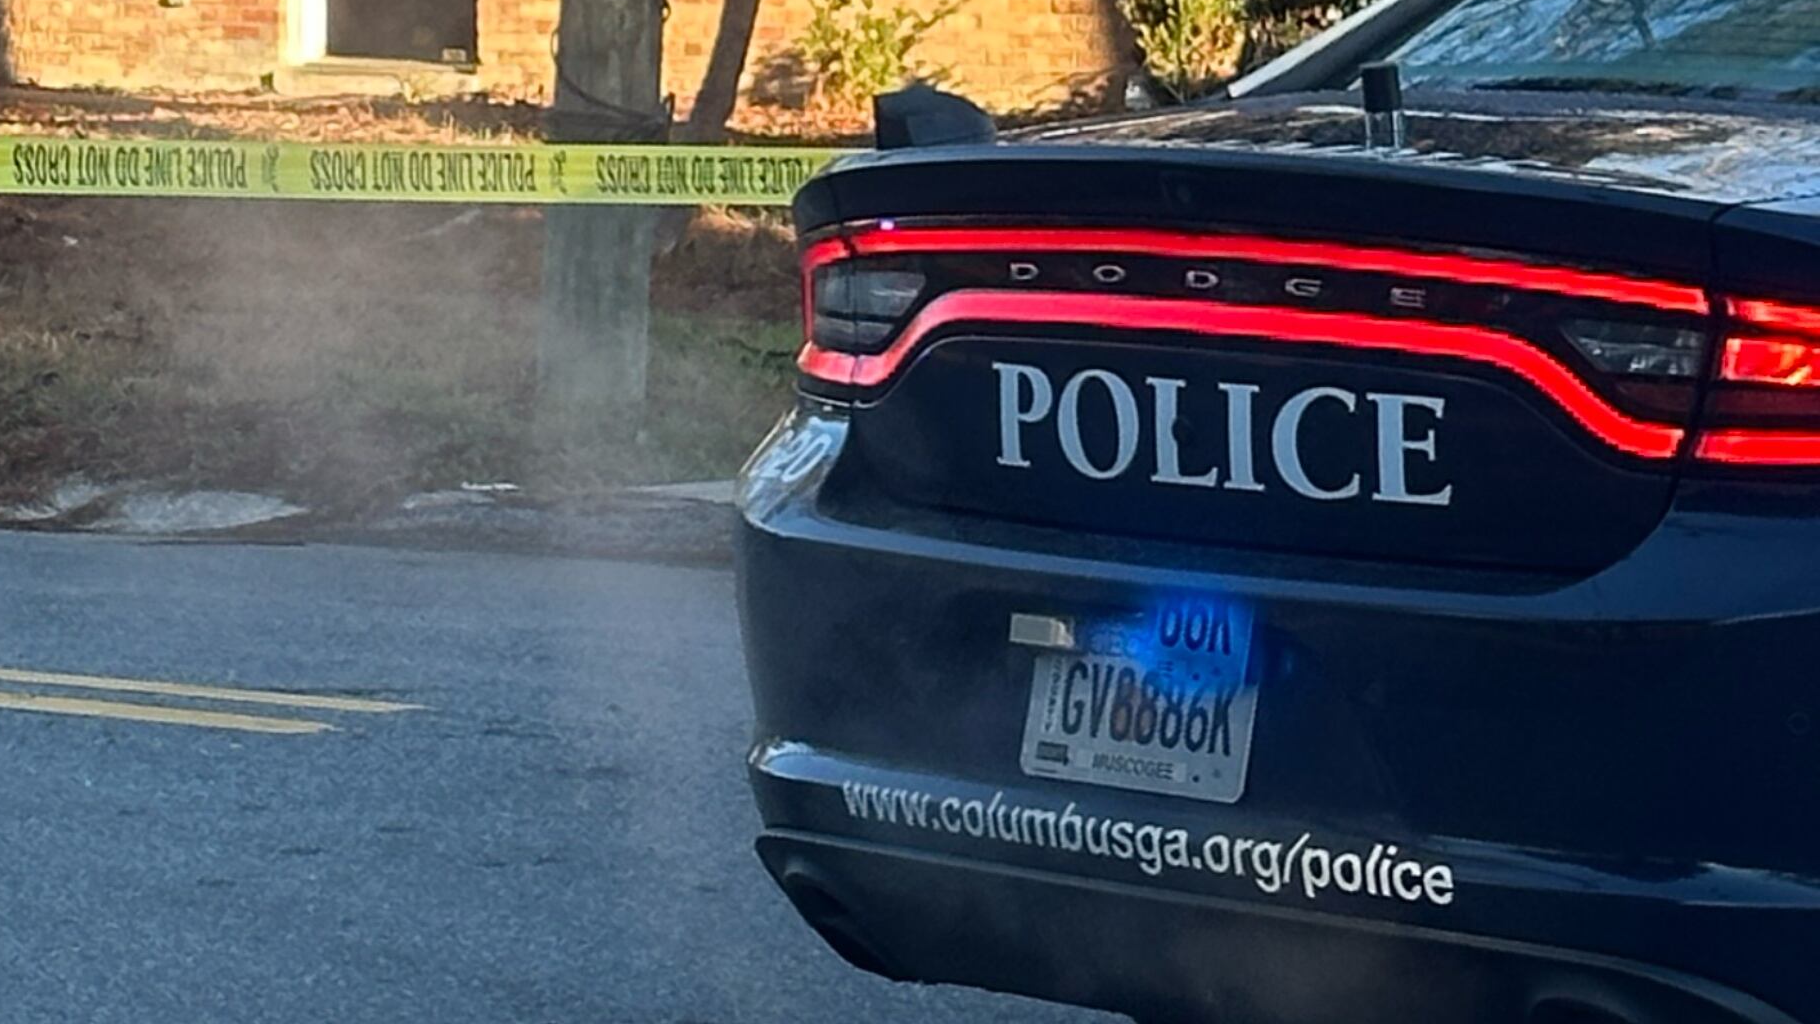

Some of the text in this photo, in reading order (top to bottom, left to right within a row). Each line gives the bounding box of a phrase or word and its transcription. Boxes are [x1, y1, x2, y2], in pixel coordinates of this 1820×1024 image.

[13, 145, 70, 187] CROSS
[76, 146, 111, 187] NOT
[114, 146, 140, 188] DO
[143, 147, 183, 189] LINE
[186, 148, 247, 189] POLICE
[310, 150, 366, 191] CROSS
[372, 151, 406, 192] NOT
[409, 152, 434, 192] DO
[436, 152, 475, 193] LINE
[477, 152, 538, 193] POLICE
[1008, 262, 1427, 308] DODGE
[991, 361, 1454, 506] POLICE
[1061, 660, 1240, 757] GV8886K
[1091, 752, 1175, 780] MUSCOGEE
[842, 781, 1454, 905] www.columbusga.org/police
